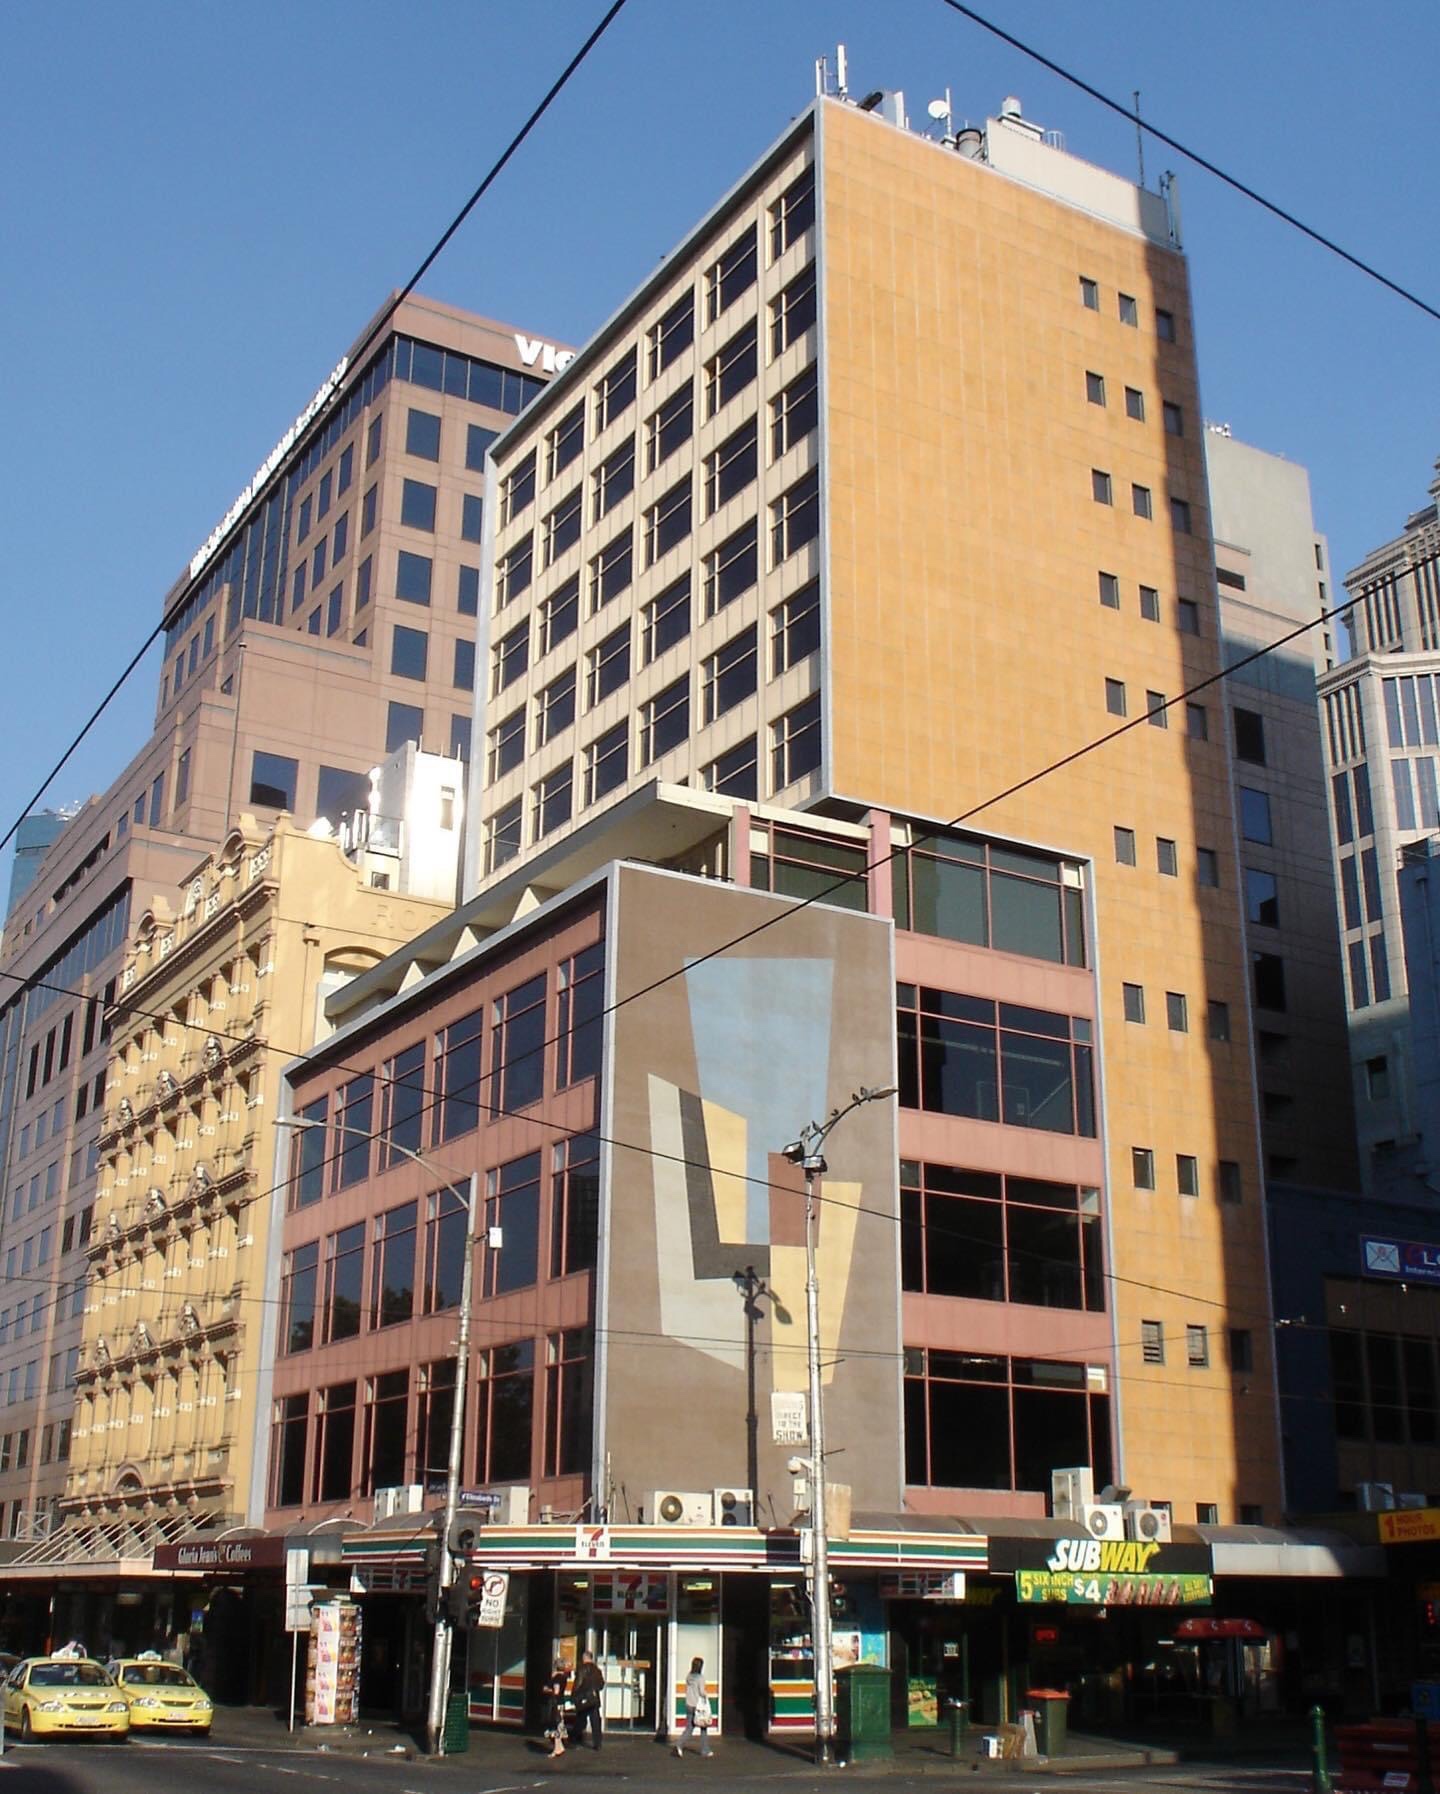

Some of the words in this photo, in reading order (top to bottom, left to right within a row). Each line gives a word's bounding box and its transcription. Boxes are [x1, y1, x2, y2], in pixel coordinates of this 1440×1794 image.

[775, 1430, 803, 1441] SHOW
[1397, 1523, 1436, 1537] PHOTOS
[583, 1526, 604, 1557] 7
[178, 1546, 199, 1564] Gloria
[226, 1543, 252, 1562] Coffees
[1047, 1538, 1160, 1573] SUBWAY
[1021, 1574, 1034, 1600] 5
[1032, 1575, 1048, 1586] SIX
[1050, 1575, 1074, 1587] INCH
[1042, 1588, 1068, 1600] SUBS
[485, 1599, 500, 1609] NO
